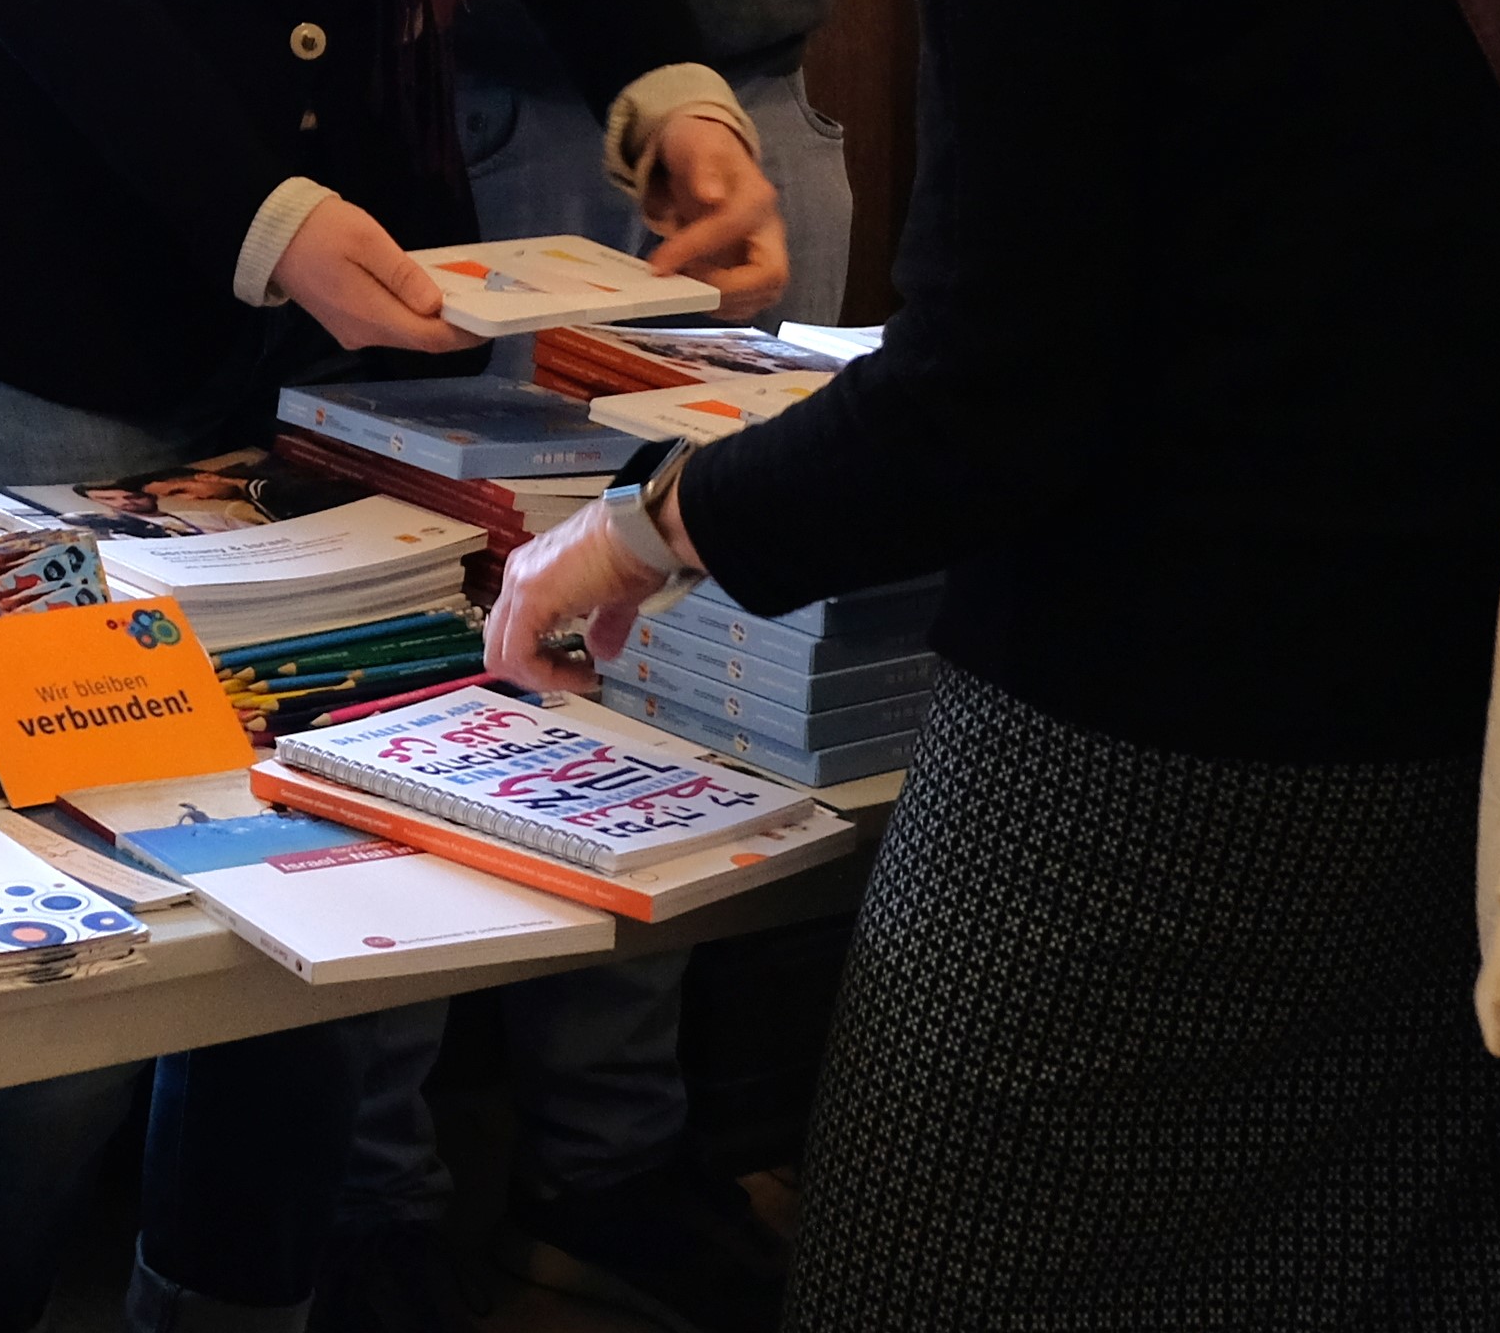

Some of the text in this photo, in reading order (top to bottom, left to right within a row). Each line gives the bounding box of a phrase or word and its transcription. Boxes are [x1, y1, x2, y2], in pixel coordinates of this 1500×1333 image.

[35, 672, 148, 705] Wir bleiben
[17, 690, 193, 741] verbunden!
[330, 700, 486, 746] DA FÄLLT MIR ABER
[444, 737, 607, 787] EIN STEIN
[279, 853, 333, 873] Israel
[350, 847, 391, 865] Nah
